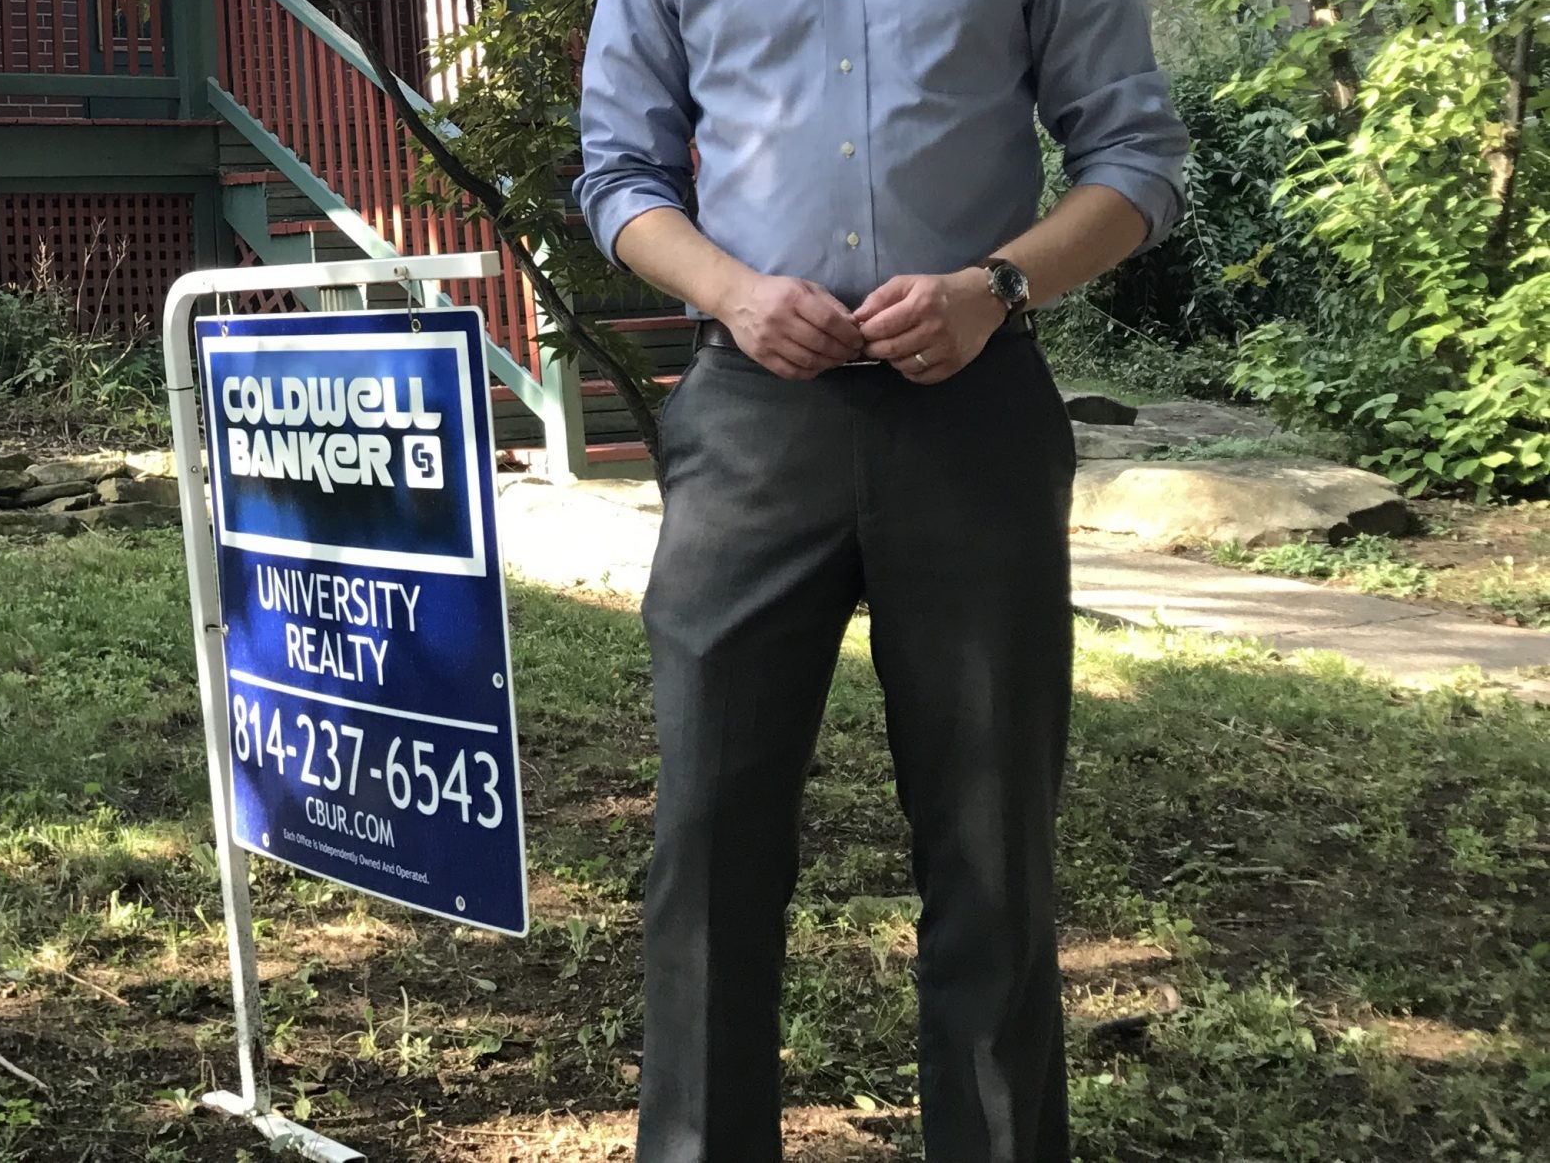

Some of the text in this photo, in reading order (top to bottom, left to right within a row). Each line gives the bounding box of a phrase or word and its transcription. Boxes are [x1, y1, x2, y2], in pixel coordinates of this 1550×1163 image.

[256, 564, 420, 632] UNIVERSITY
[285, 623, 388, 686] REALTY
[234, 694, 503, 829] 814-237-6543
[305, 796, 395, 848] CBUR.COM
[283, 828, 295, 841] Each
[296, 833, 312, 847] Office
[318, 841, 358, 865] Independently
[359, 854, 380, 870] Owned
[382, 862, 395, 874] And
[395, 865, 430, 884] Operated.
